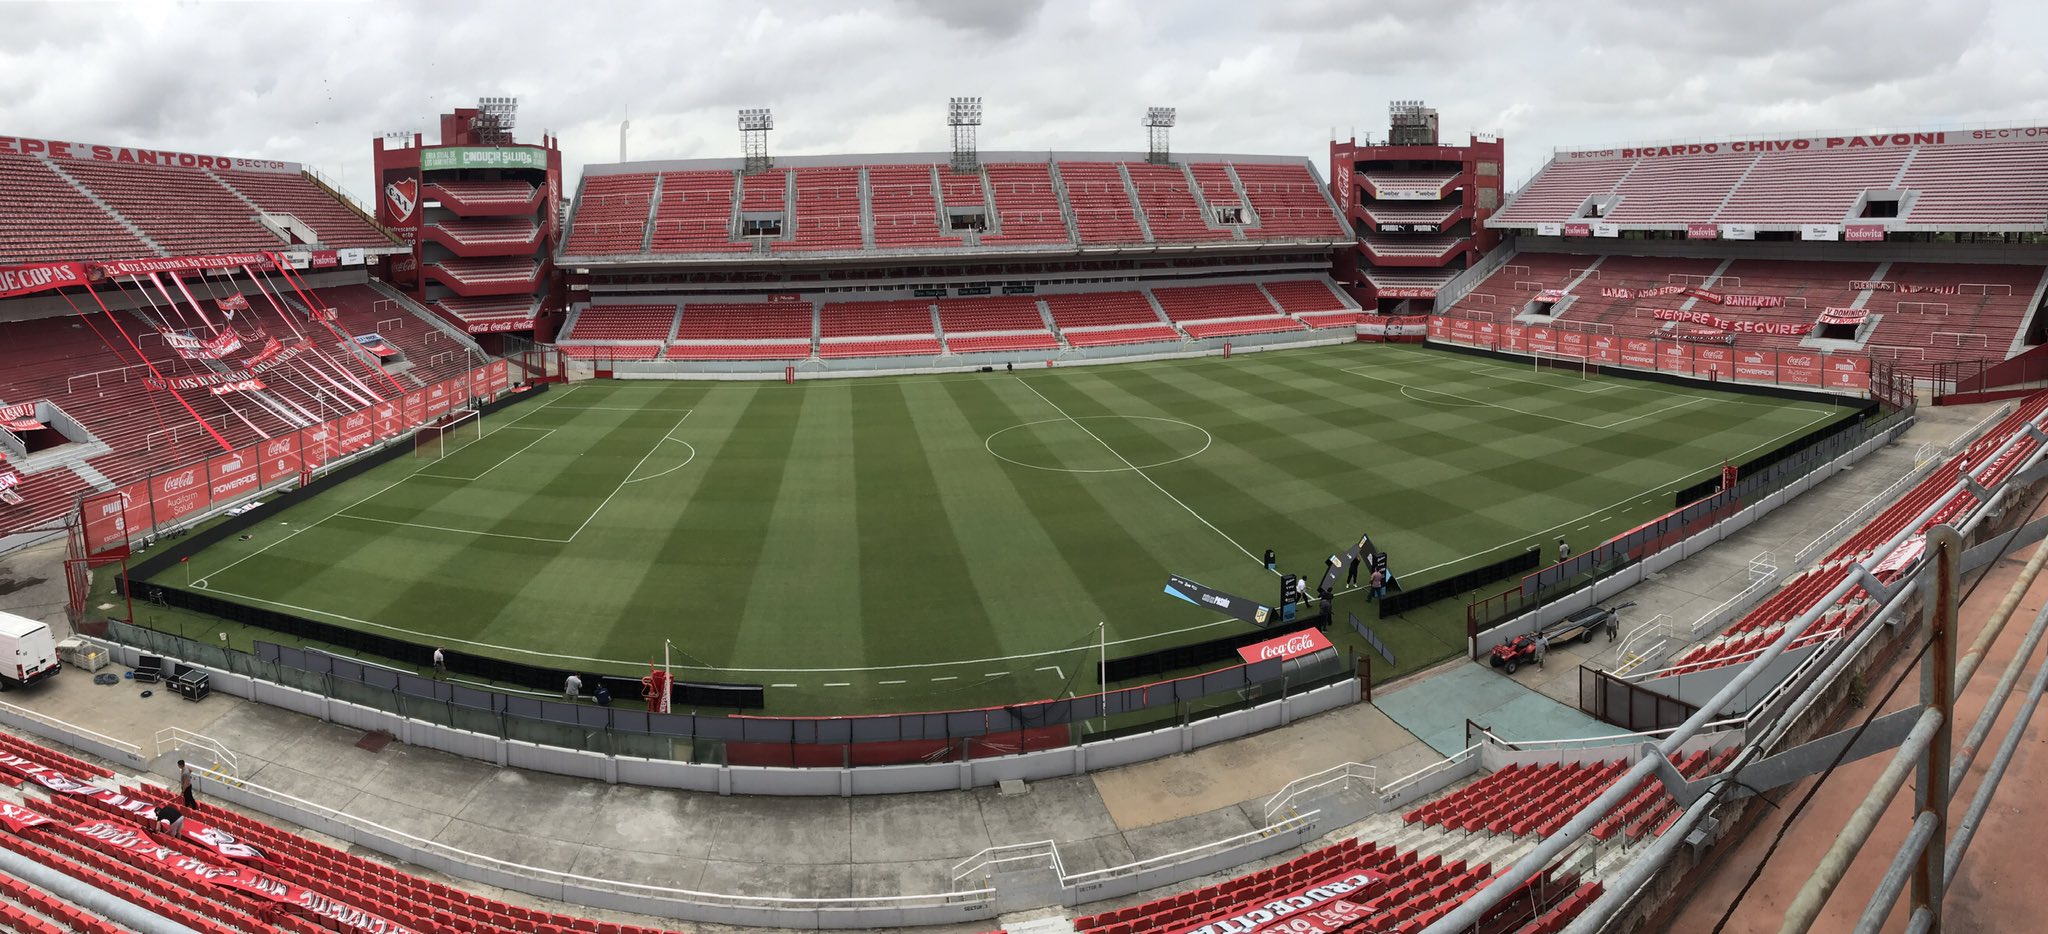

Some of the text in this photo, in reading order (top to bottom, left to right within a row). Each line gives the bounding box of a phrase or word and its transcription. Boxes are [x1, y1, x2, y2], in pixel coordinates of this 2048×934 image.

[1972, 126, 2048, 139] SECTOR
[1570, 149, 1614, 159] SECTOR
[1622, 143, 1719, 159] RICARDO
[1826, 132, 1945, 149] PAVONI
[92, 144, 232, 170] SANTORO
[236, 158, 285, 170] SECTOR
[1381, 224, 1398, 232] PUMA
[1413, 224, 1431, 232] PUMA
[1846, 228, 1883, 239] Fosfovita
[18, 264, 77, 288] COPAS
[1653, 309, 1711, 325] SIEMPRE
[1714, 317, 1730, 329] TE
[1736, 366, 1775, 377] POWERADE
[213, 472, 257, 496] POWERADE
[1261, 633, 1315, 660] Coca-Cola
